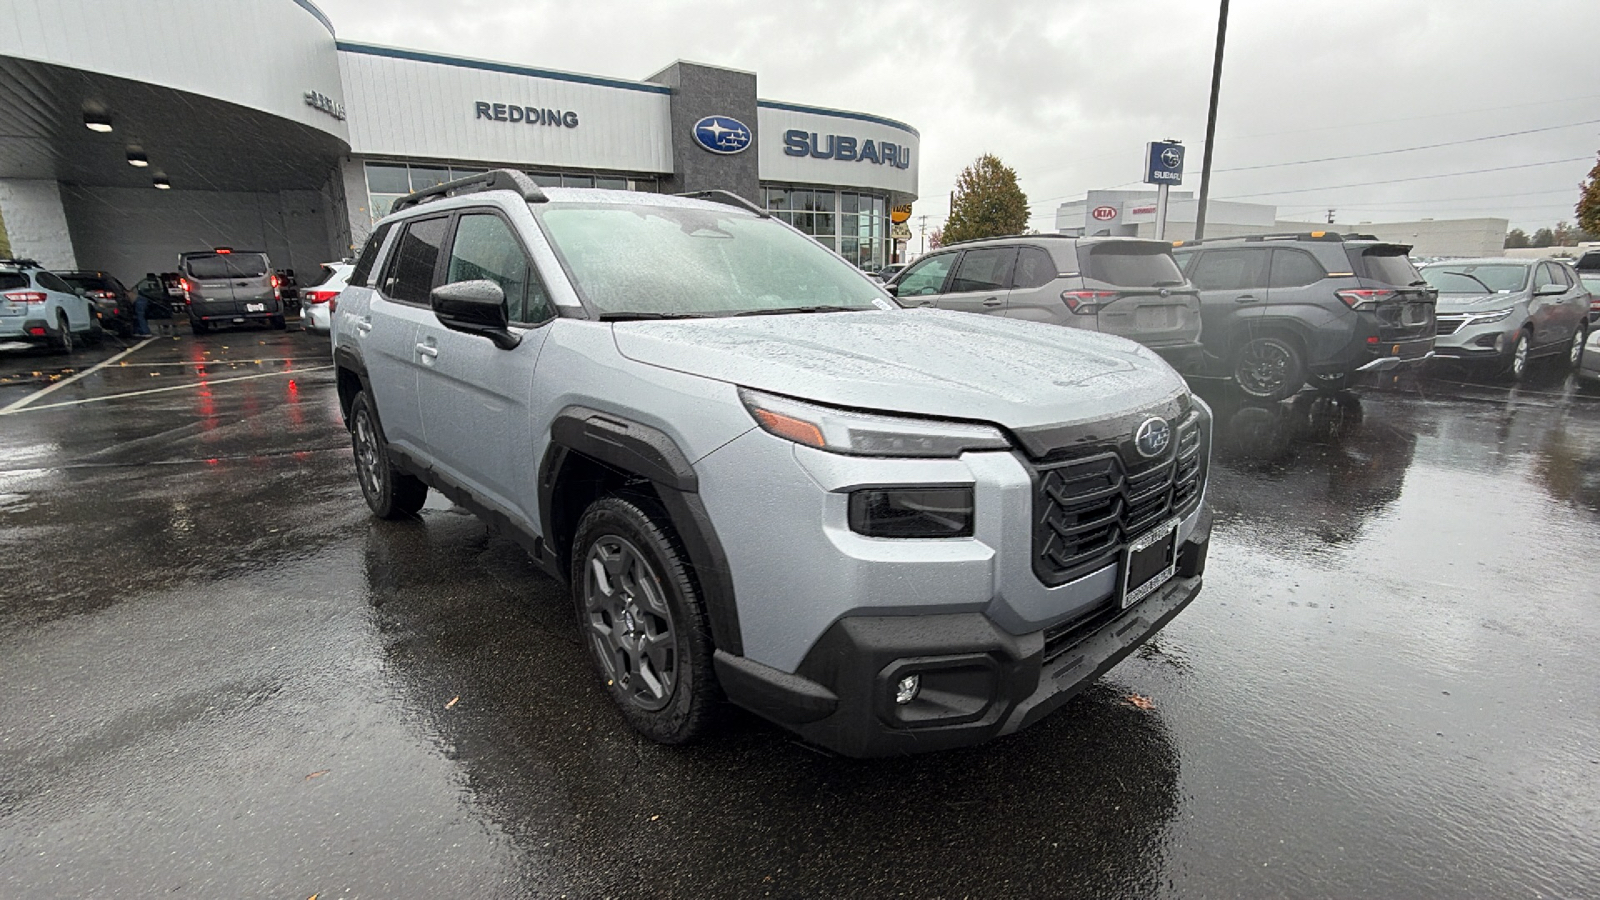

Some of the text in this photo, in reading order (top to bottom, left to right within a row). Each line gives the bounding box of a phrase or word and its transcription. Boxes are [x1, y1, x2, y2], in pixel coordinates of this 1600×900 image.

[475, 101, 579, 128] REDDING
[783, 129, 910, 169] SUBARU
[1154, 170, 1181, 180] SUBARU
[1095, 208, 1114, 219] KIA
